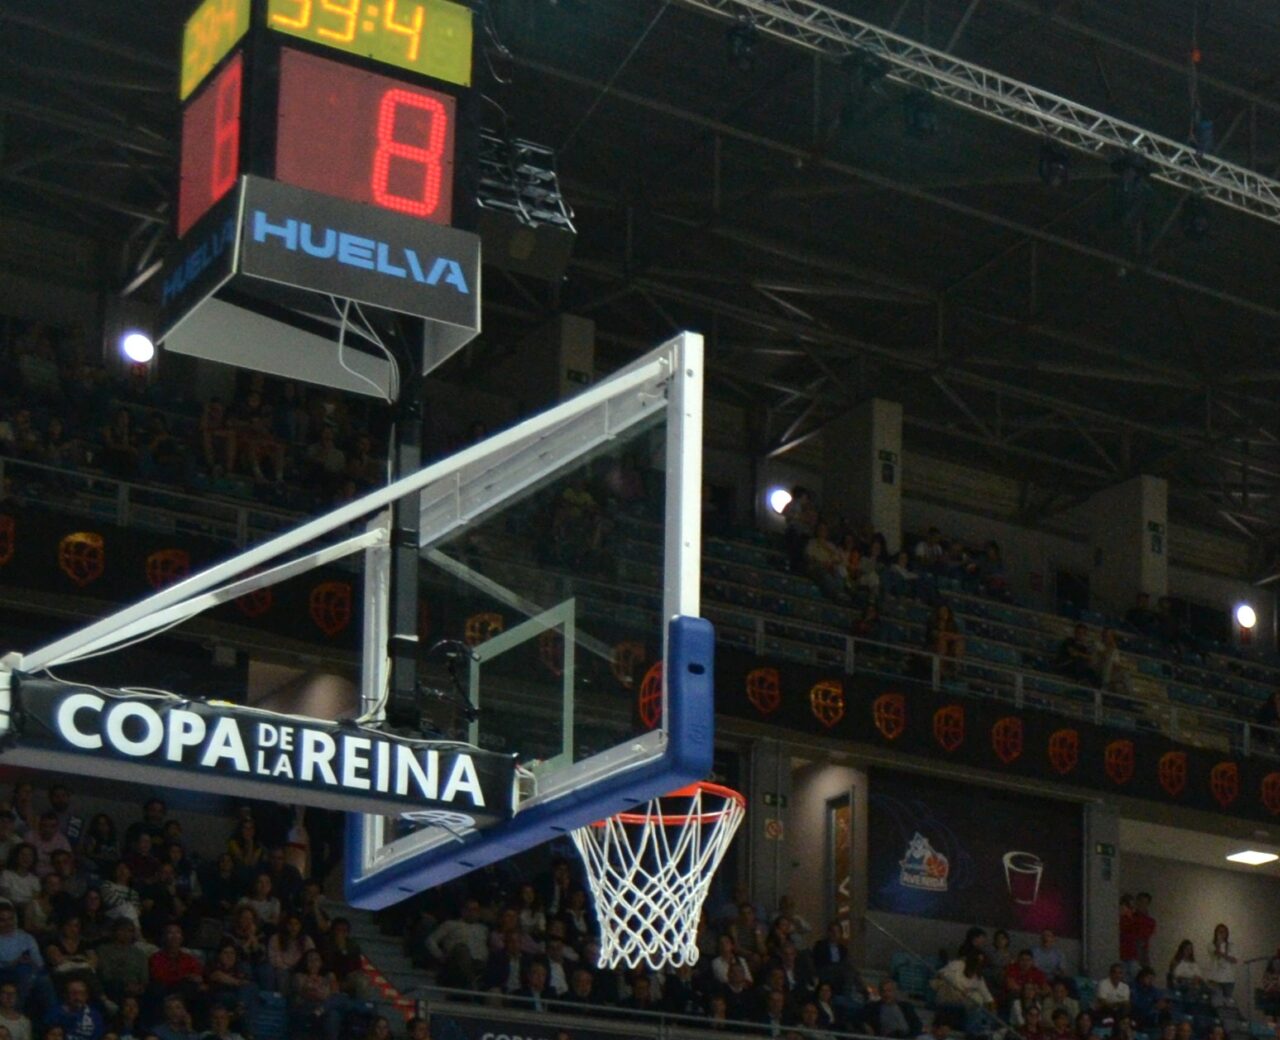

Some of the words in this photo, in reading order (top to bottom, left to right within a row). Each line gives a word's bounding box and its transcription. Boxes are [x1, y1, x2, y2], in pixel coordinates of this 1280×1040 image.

[371, 87, 448, 217] 8
[254, 210, 470, 294] HUELVA
[56, 693, 251, 773] COPA
[256, 750, 294, 780] LA
[257, 722, 294, 752] DE
[301, 728, 486, 808] REINA
